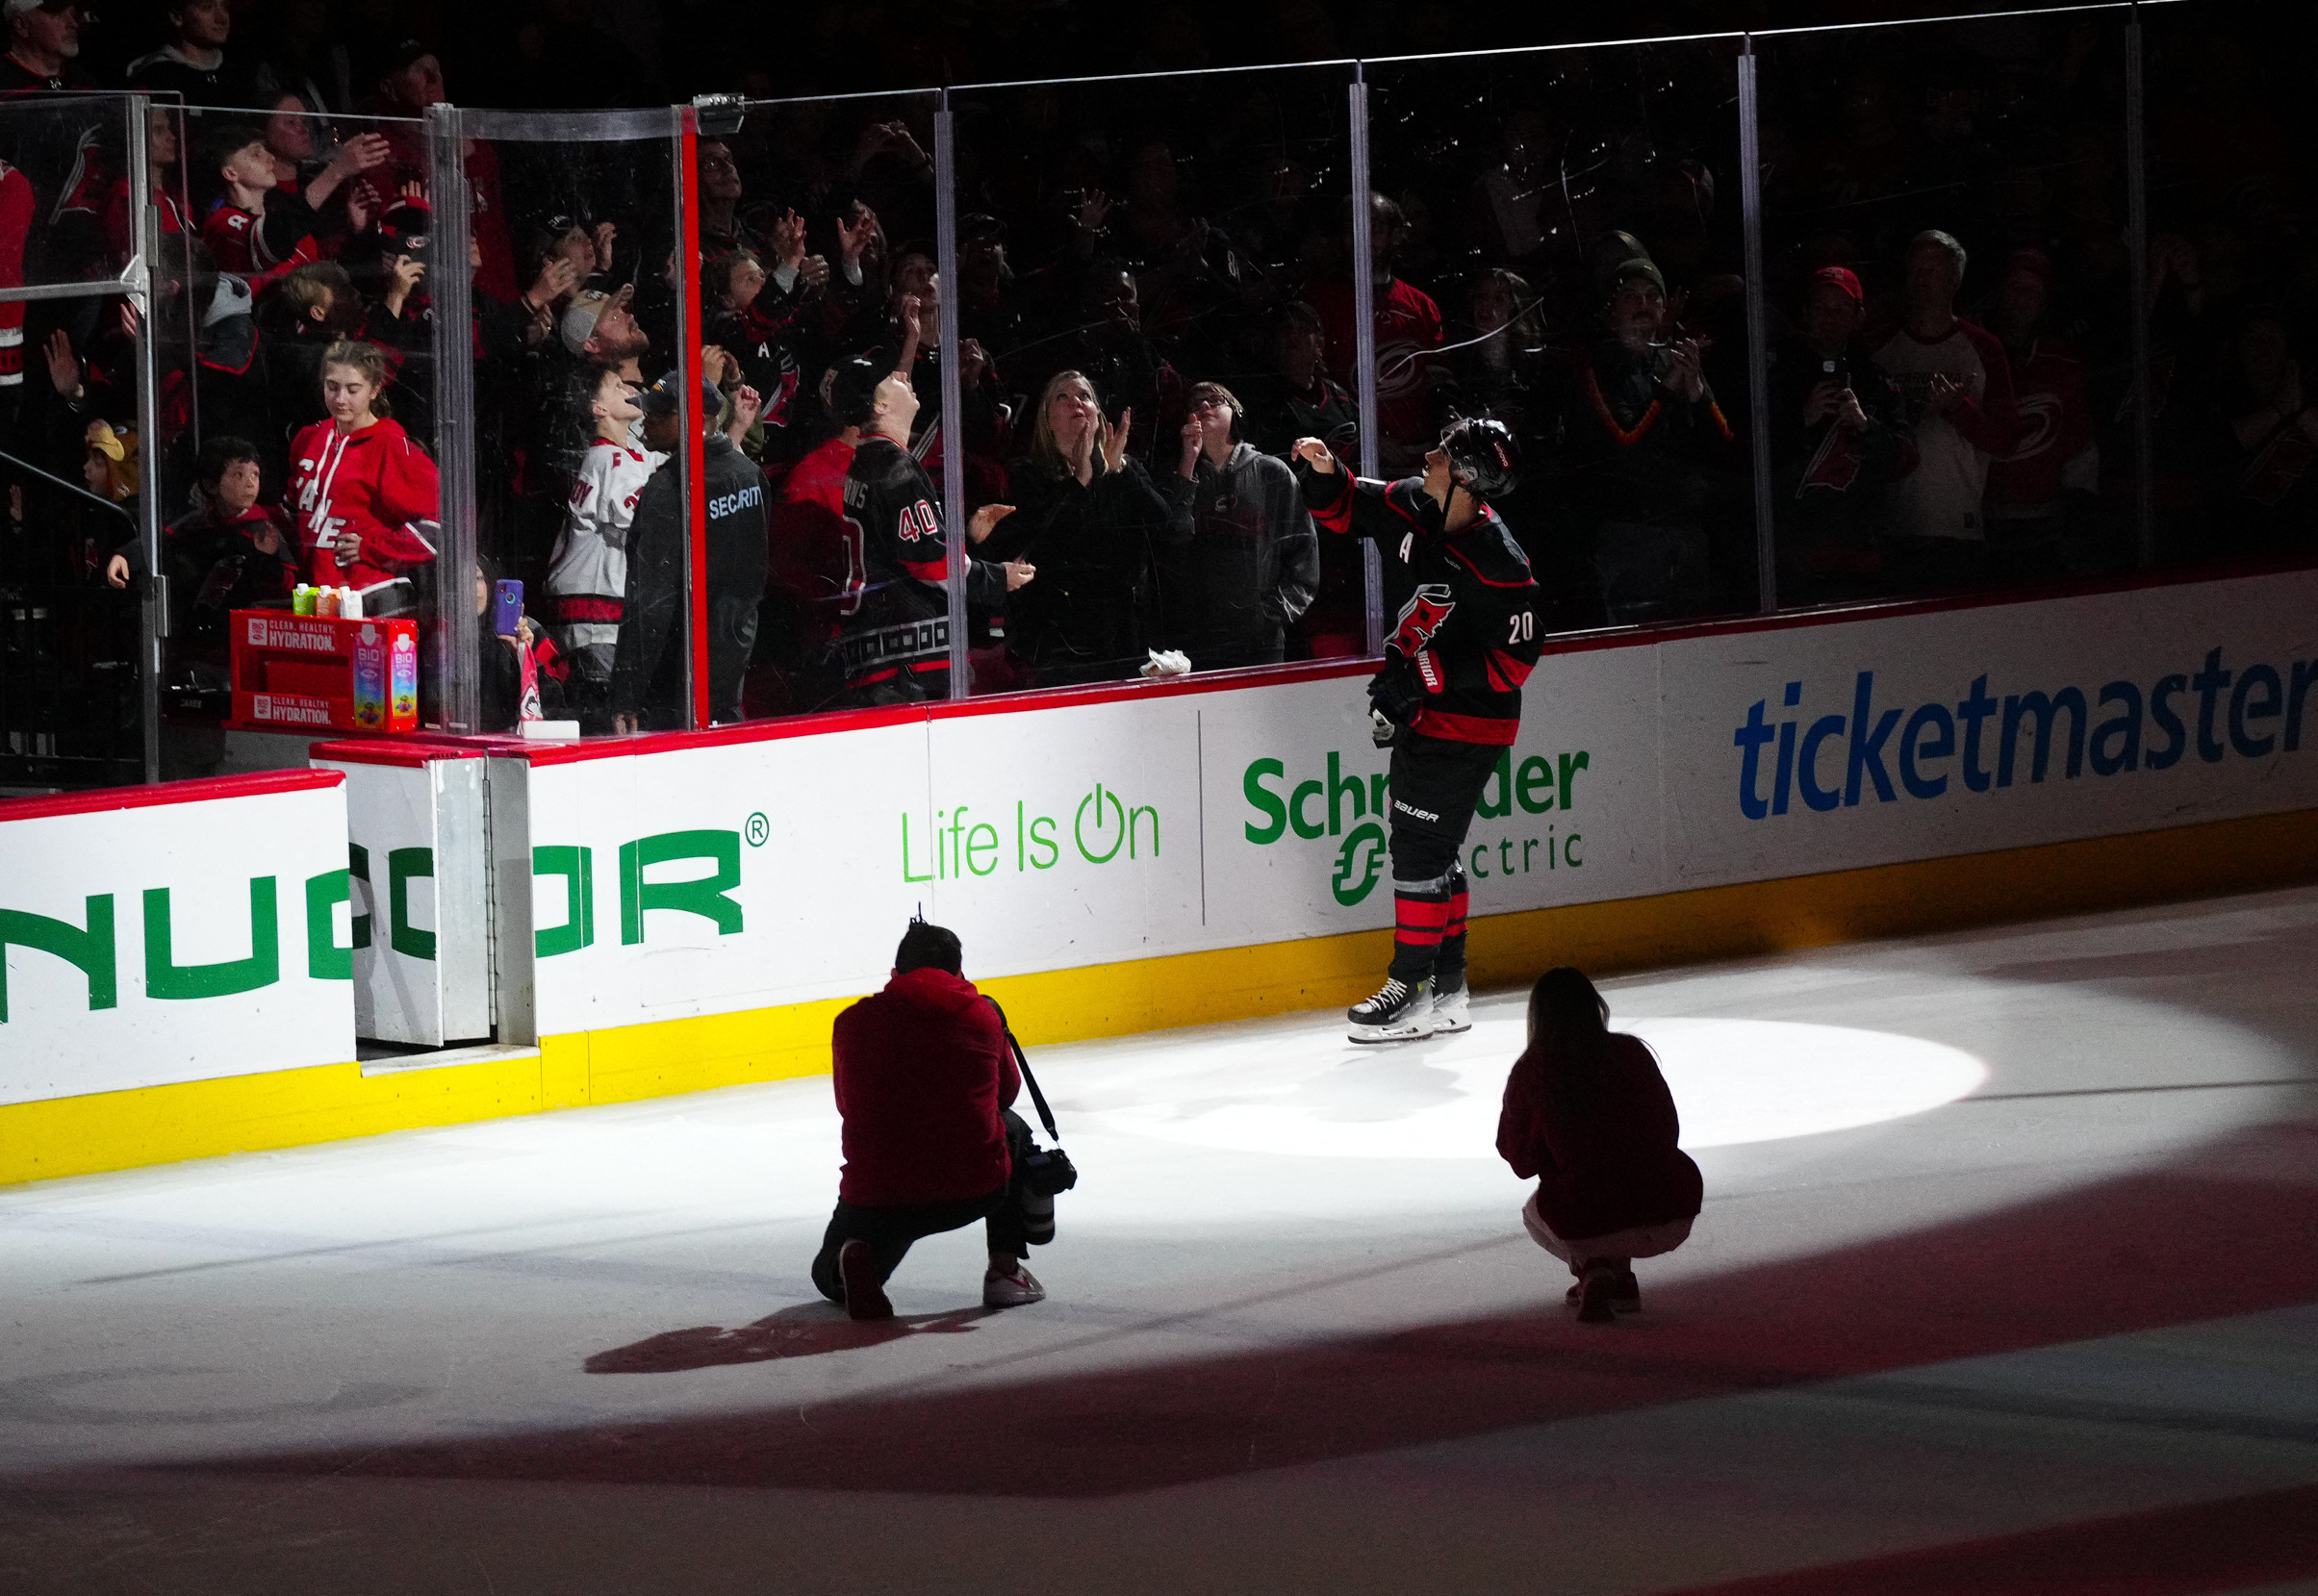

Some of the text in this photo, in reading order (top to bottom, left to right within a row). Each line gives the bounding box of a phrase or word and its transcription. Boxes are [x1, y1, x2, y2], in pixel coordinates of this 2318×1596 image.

[898, 498, 938, 544] 40
[1398, 531, 1414, 565] A
[268, 630, 336, 652] HYDRATION.
[1507, 611, 1534, 646] 20
[357, 647, 380, 662] BIO
[395, 652, 413, 664] BIO
[272, 705, 332, 725] HYDRATION.
[1734, 646, 2318, 821] ticketmaster
[1243, 747, 1590, 845] Schder
[902, 782, 1159, 883] Life Is On
[1470, 824, 1584, 879] ctric
